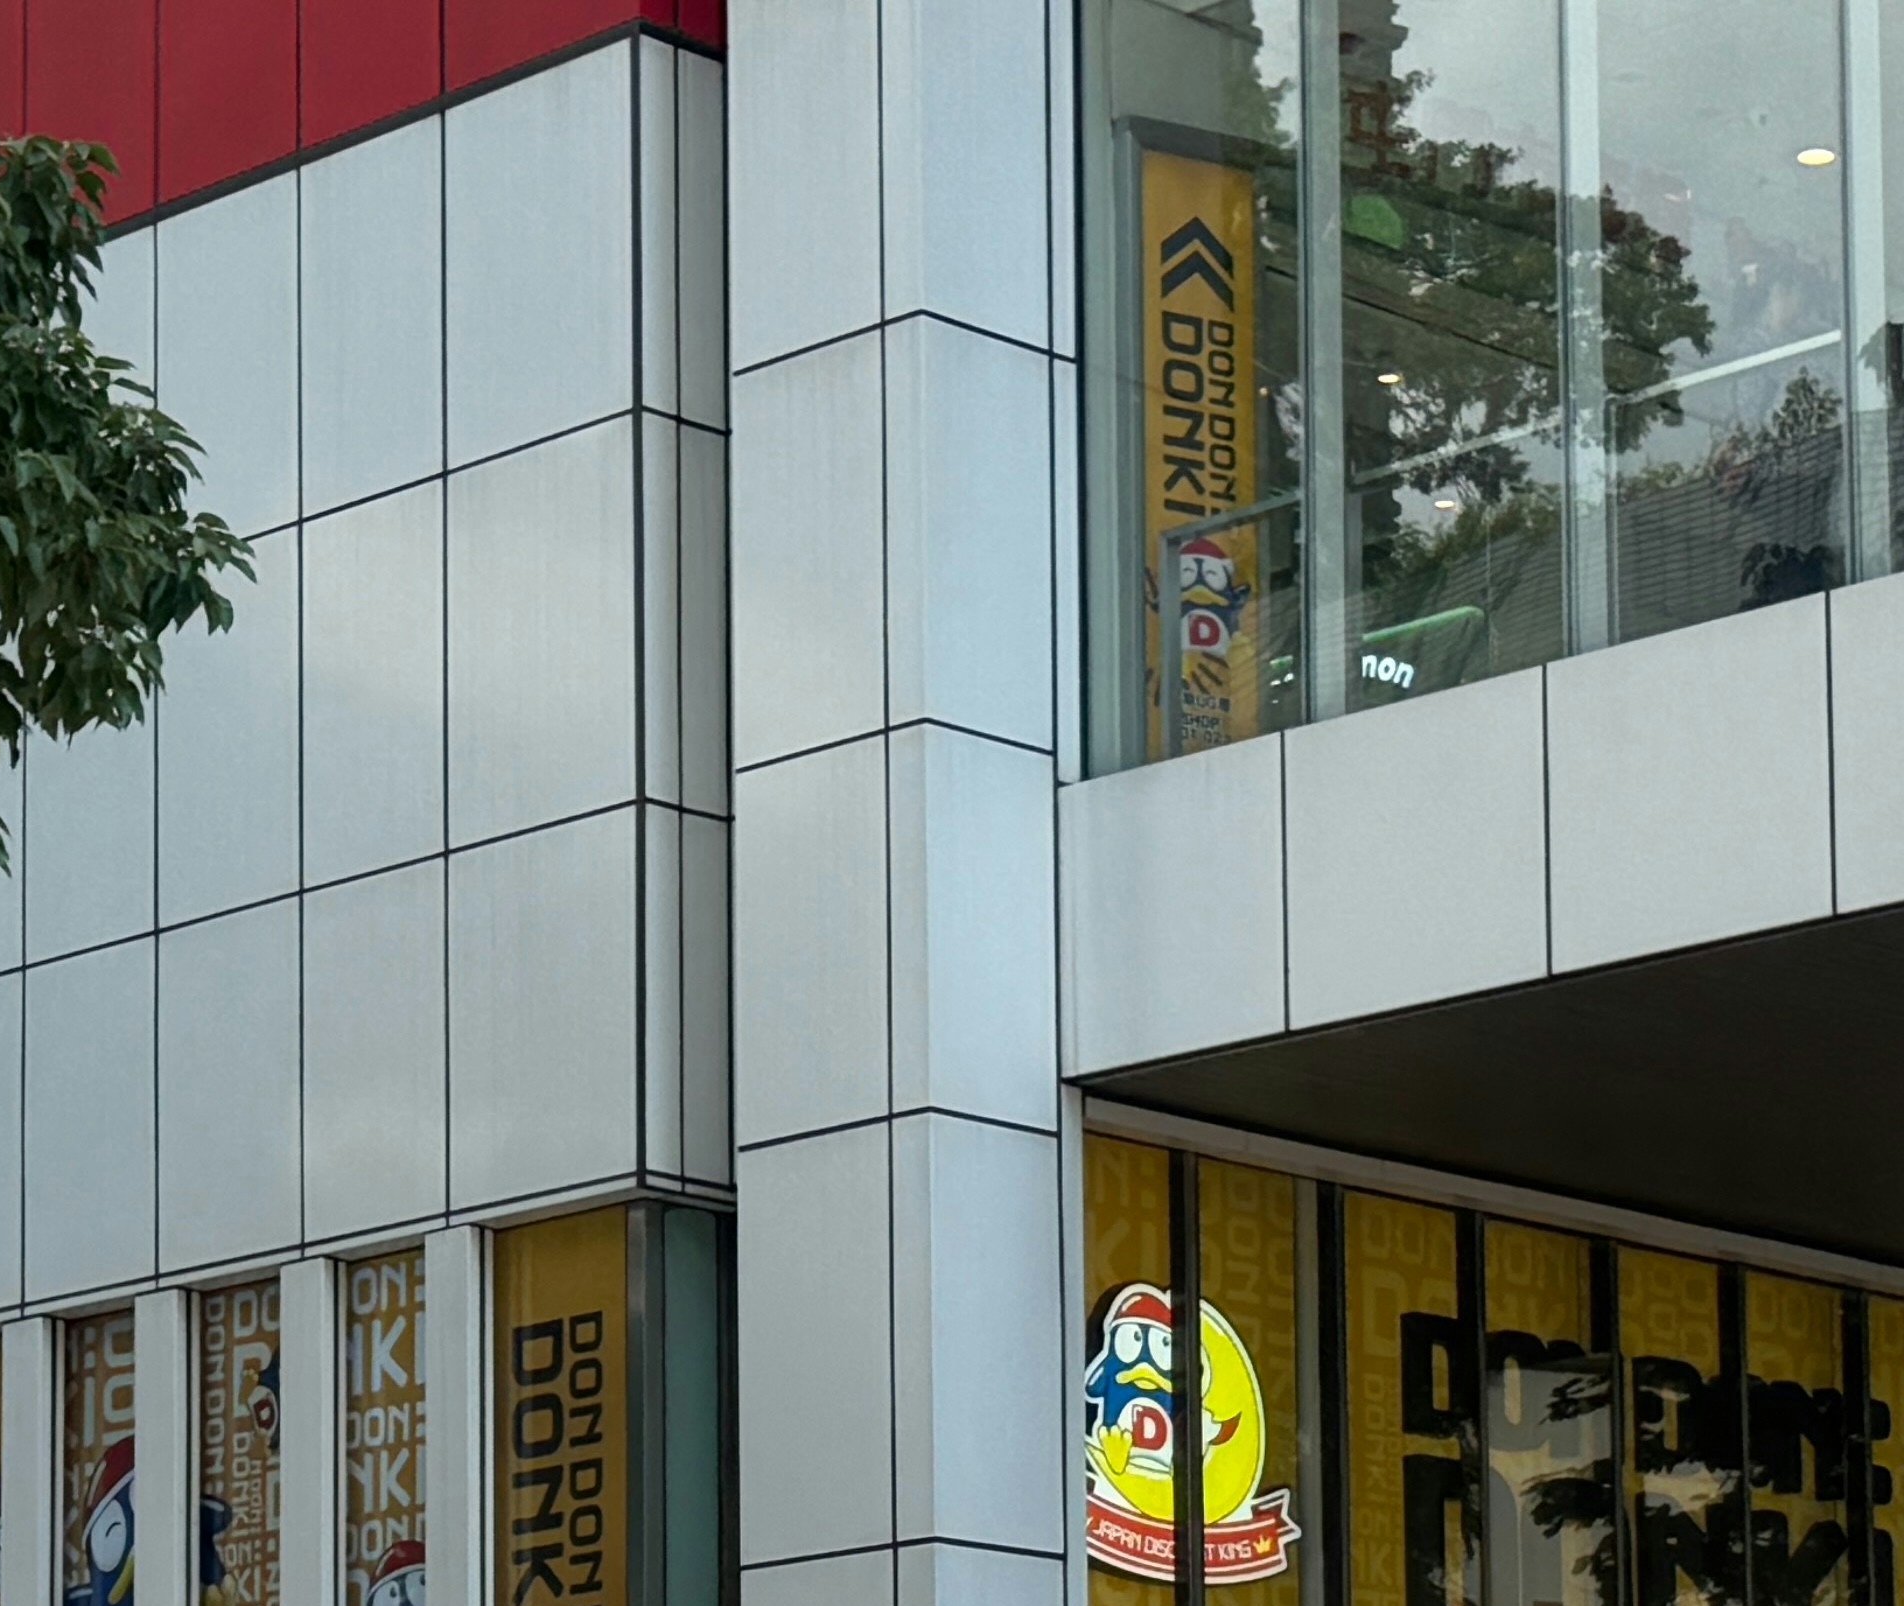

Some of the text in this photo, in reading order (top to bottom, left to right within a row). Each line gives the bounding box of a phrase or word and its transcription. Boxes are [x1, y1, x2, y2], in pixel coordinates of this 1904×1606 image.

[1159, 309, 1207, 517] DONKI
[568, 1311, 603, 1447] DON
[1092, 1519, 1143, 1551] JAPAN
[1218, 1540, 1252, 1560] KING
